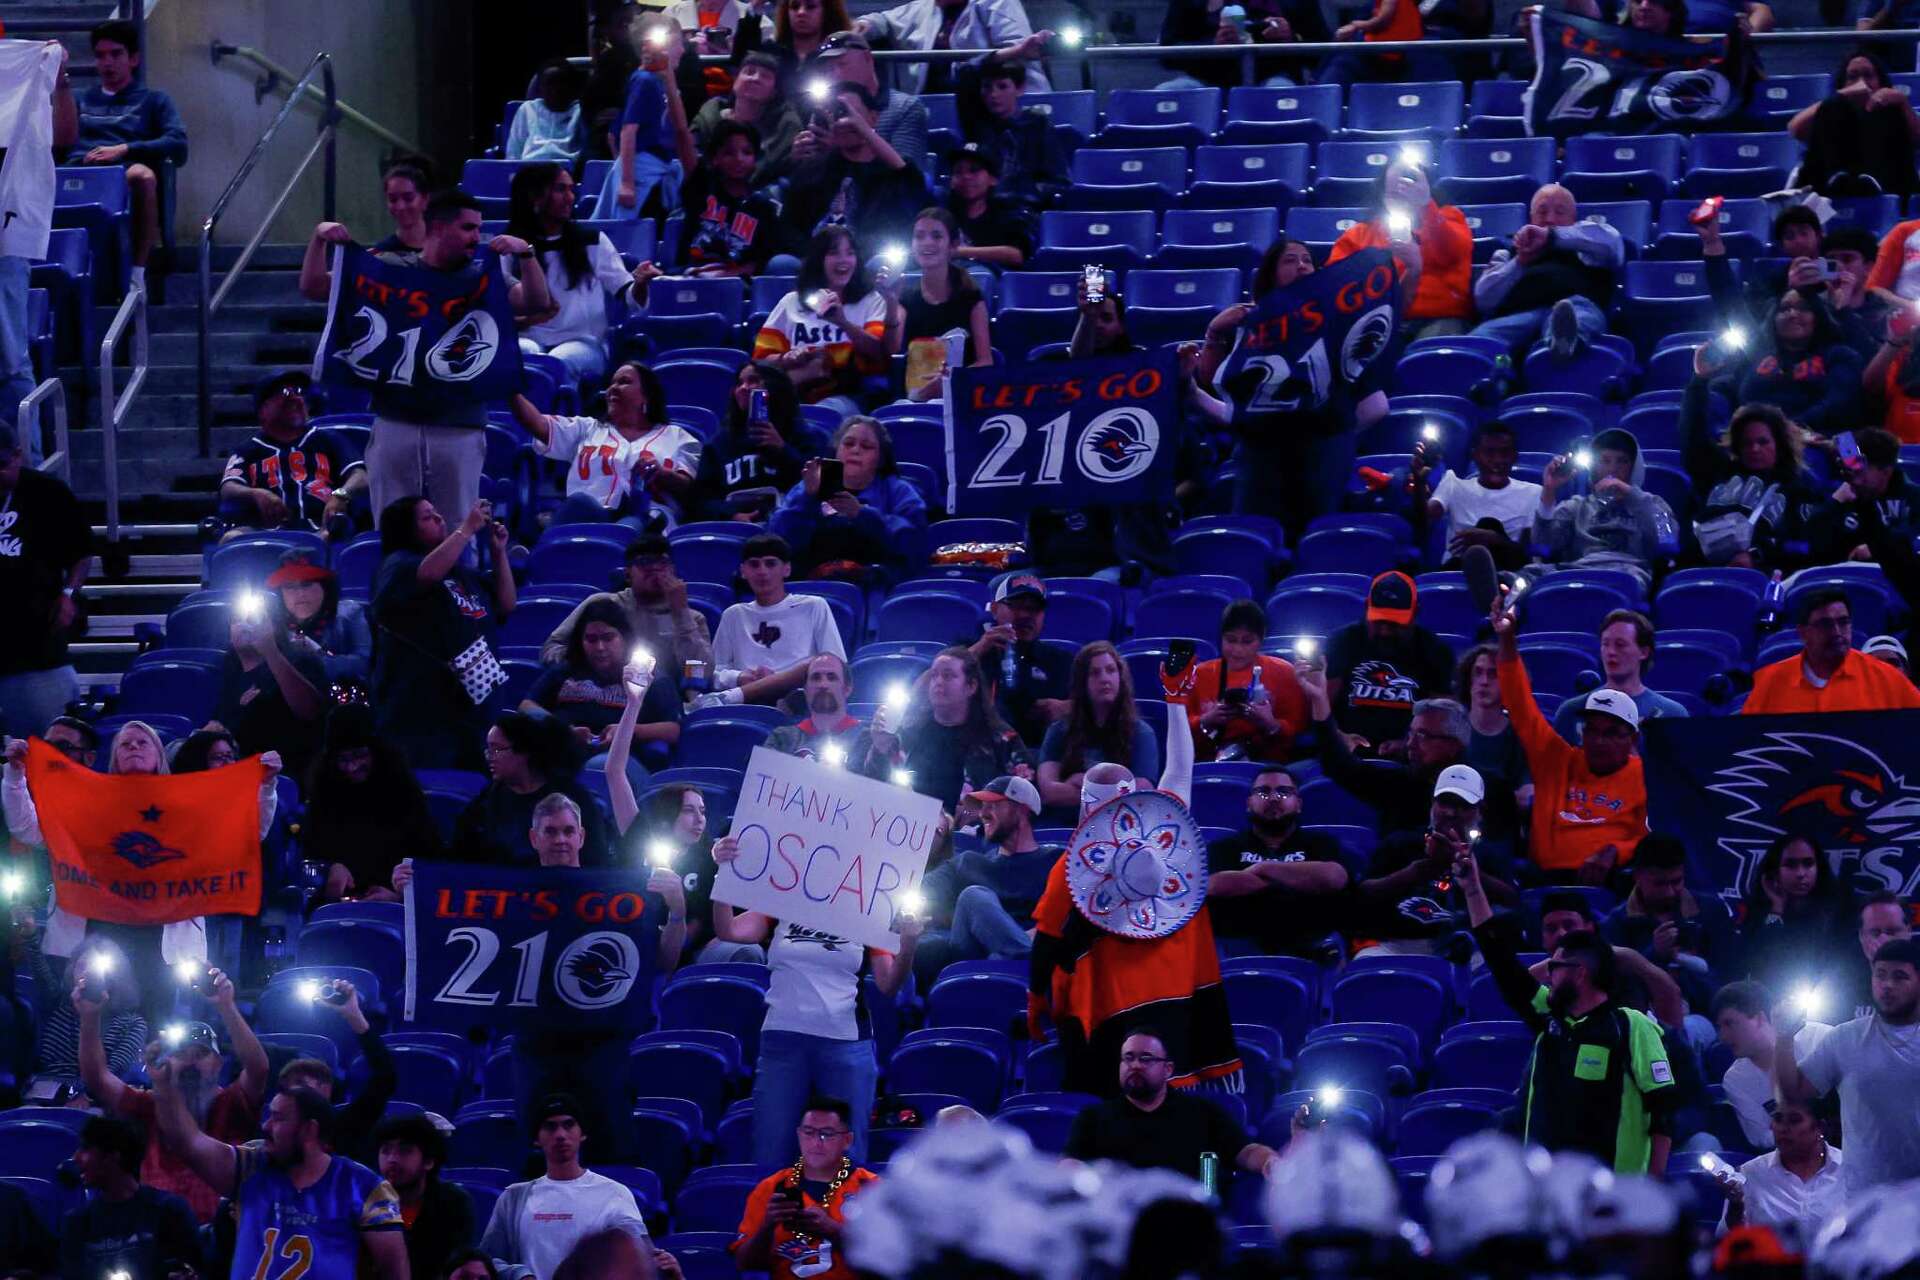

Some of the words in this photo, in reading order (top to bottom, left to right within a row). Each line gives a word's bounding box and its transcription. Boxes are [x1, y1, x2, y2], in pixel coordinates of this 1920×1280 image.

[1335, 265, 1393, 314] GO
[331, 305, 500, 388] 210
[1245, 304, 1394, 413] 210
[970, 377, 1084, 410] LET'S
[1098, 368, 1163, 401] GO
[967, 406, 1161, 489] 210
[1355, 683, 1412, 703] UTSA
[754, 772, 853, 832] THANK
[870, 807, 928, 852] YOU
[110, 877, 158, 901] AND
[165, 872, 225, 898] TAKE
[230, 870, 248, 891] IT
[433, 887, 560, 921] LET'S
[575, 891, 647, 924] GO
[432, 926, 641, 1011] 210
